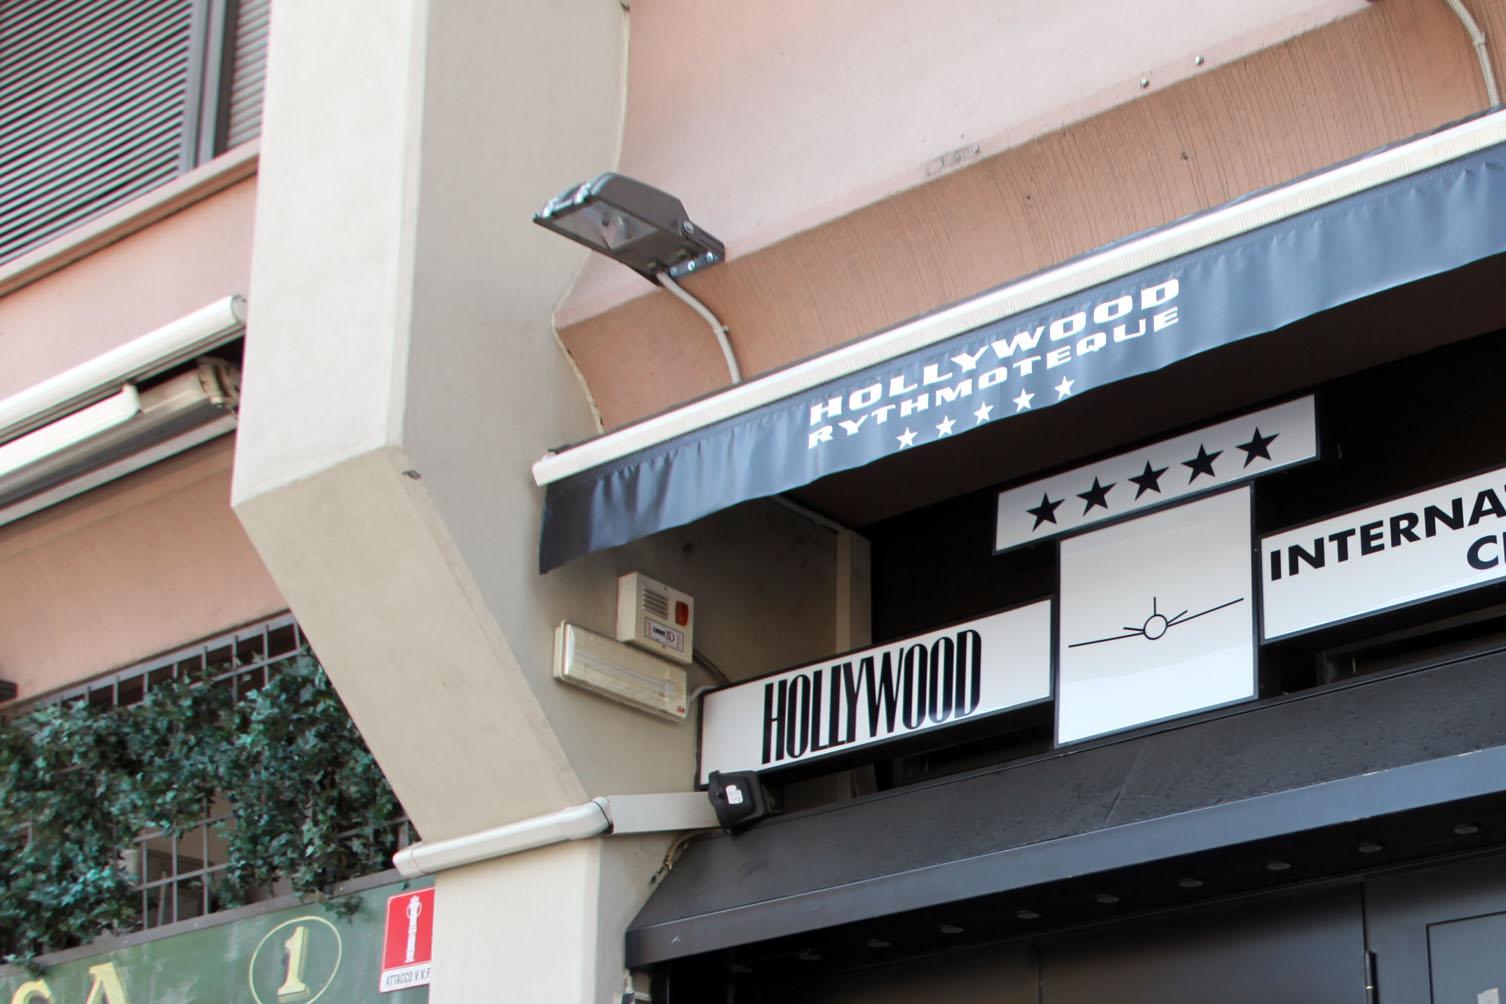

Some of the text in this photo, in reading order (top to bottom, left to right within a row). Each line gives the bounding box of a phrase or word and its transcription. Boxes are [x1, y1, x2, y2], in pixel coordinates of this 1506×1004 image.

[807, 306, 1180, 450] RYTHMOTEQUE
[809, 278, 1180, 427] HOLLYWOOD
[761, 629, 983, 765] HOLLYWOOD
[277, 926, 309, 1001] 1
[385, 971, 414, 986] ATTACCO
